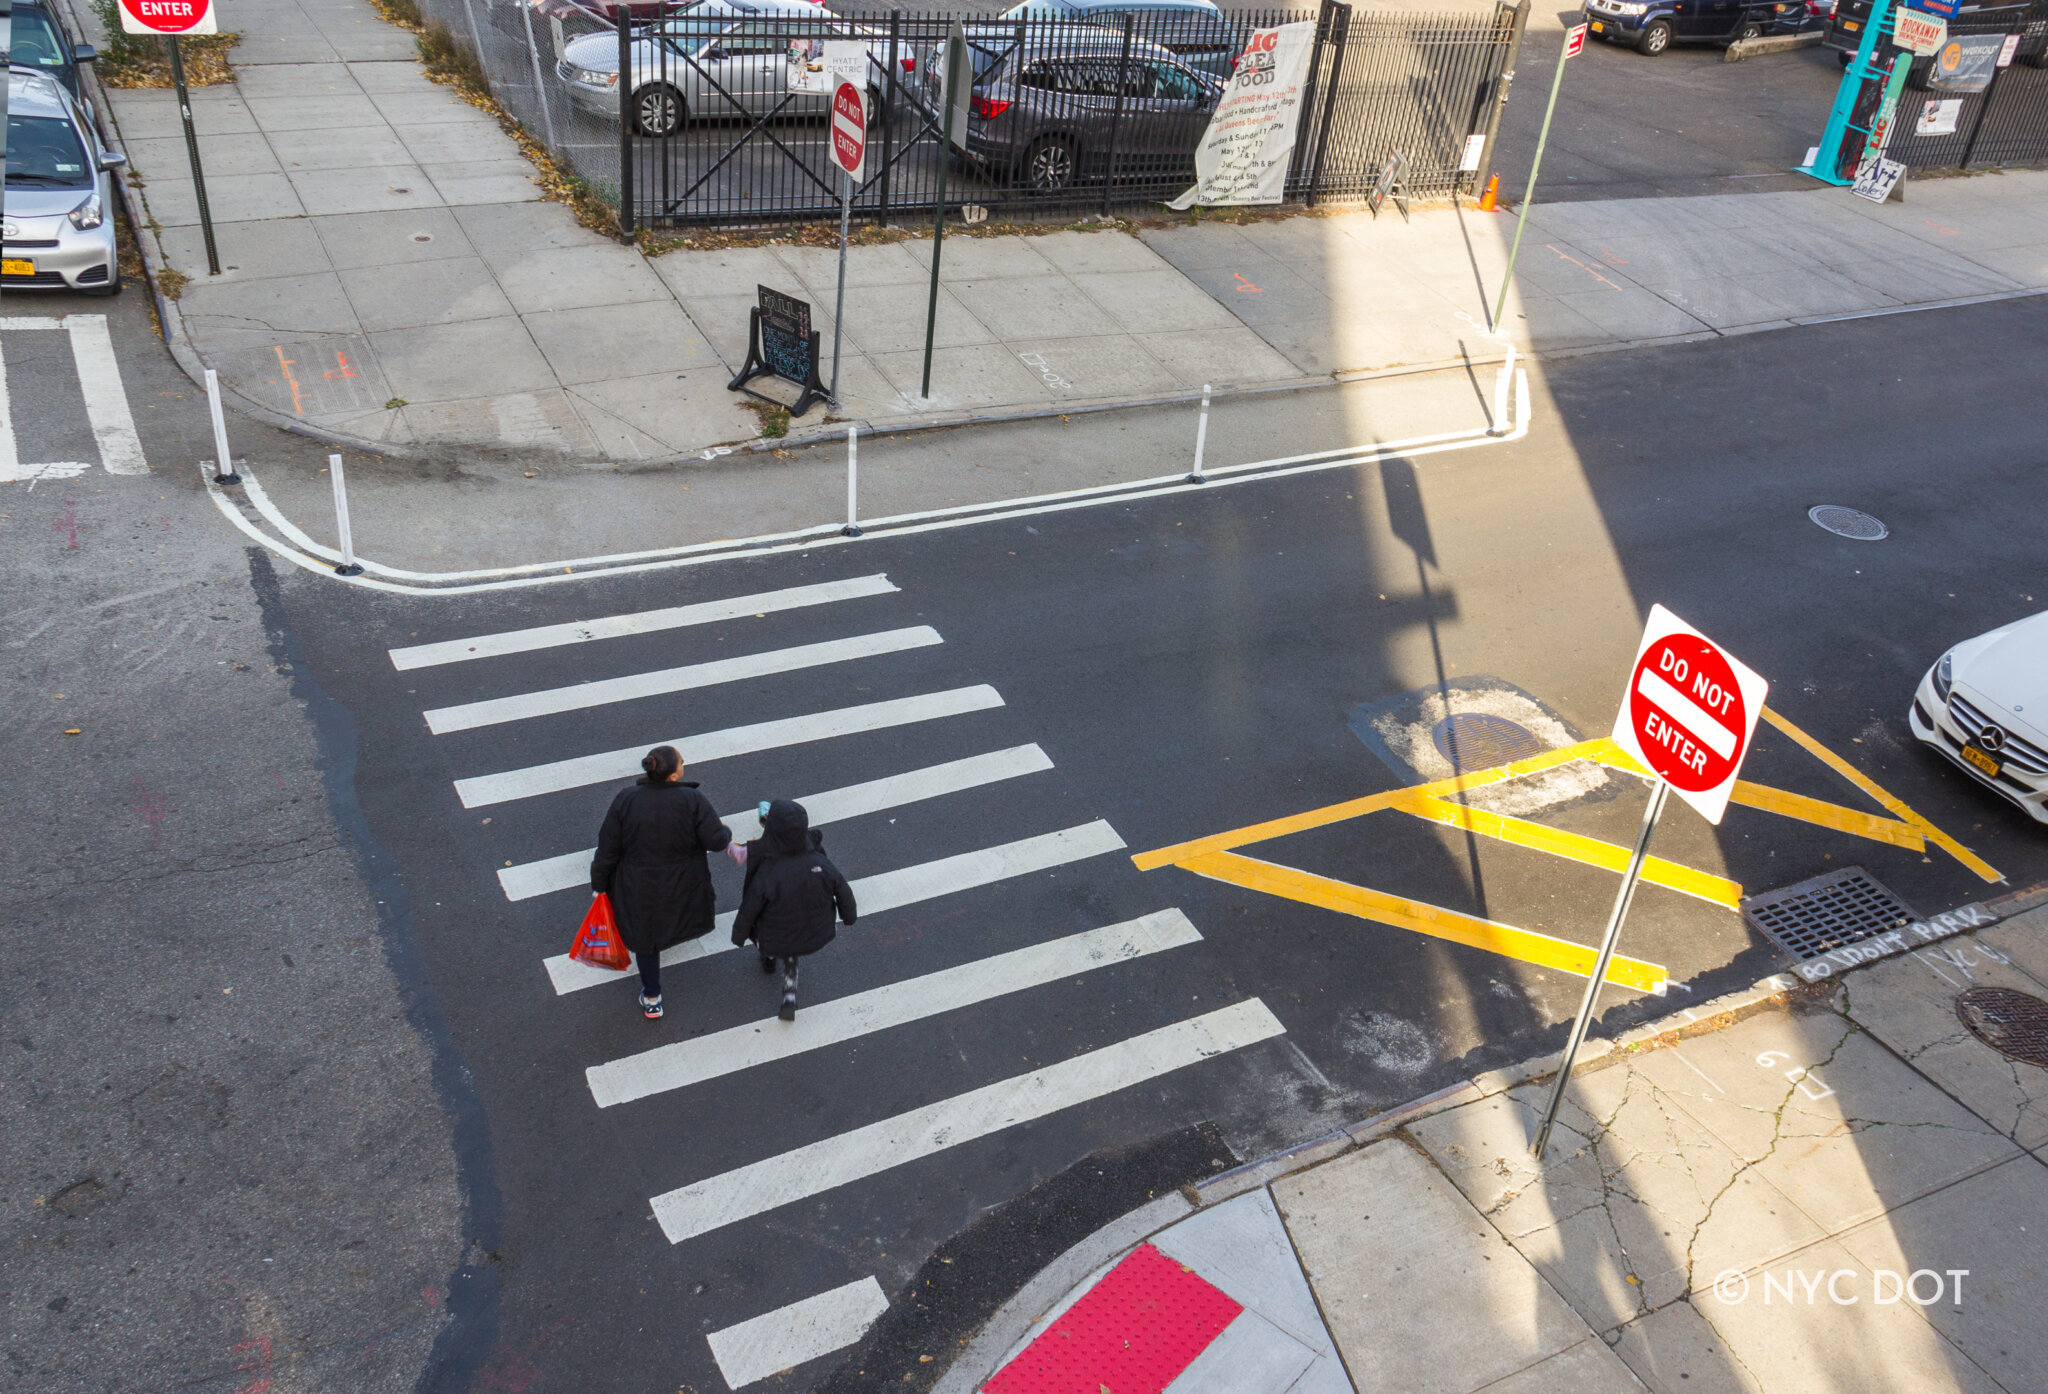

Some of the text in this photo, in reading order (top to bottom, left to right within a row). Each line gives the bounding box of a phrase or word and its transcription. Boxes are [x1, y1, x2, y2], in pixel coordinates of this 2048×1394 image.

[141, 2, 193, 16] ENTER
[1901, 18, 1941, 40] ROCKAWAY
[826, 65, 863, 74] CENTRIC
[832, 57, 858, 65] HYATT
[838, 95, 860, 121] DO NOT
[1869, 117, 1888, 150] LIC
[838, 135, 857, 160] ENTER
[1860, 157, 1897, 187] Art
[1659, 647, 1735, 716] DO NOT
[1644, 711, 1707, 776] ENTER
[1912, 907, 1998, 940] PARK
